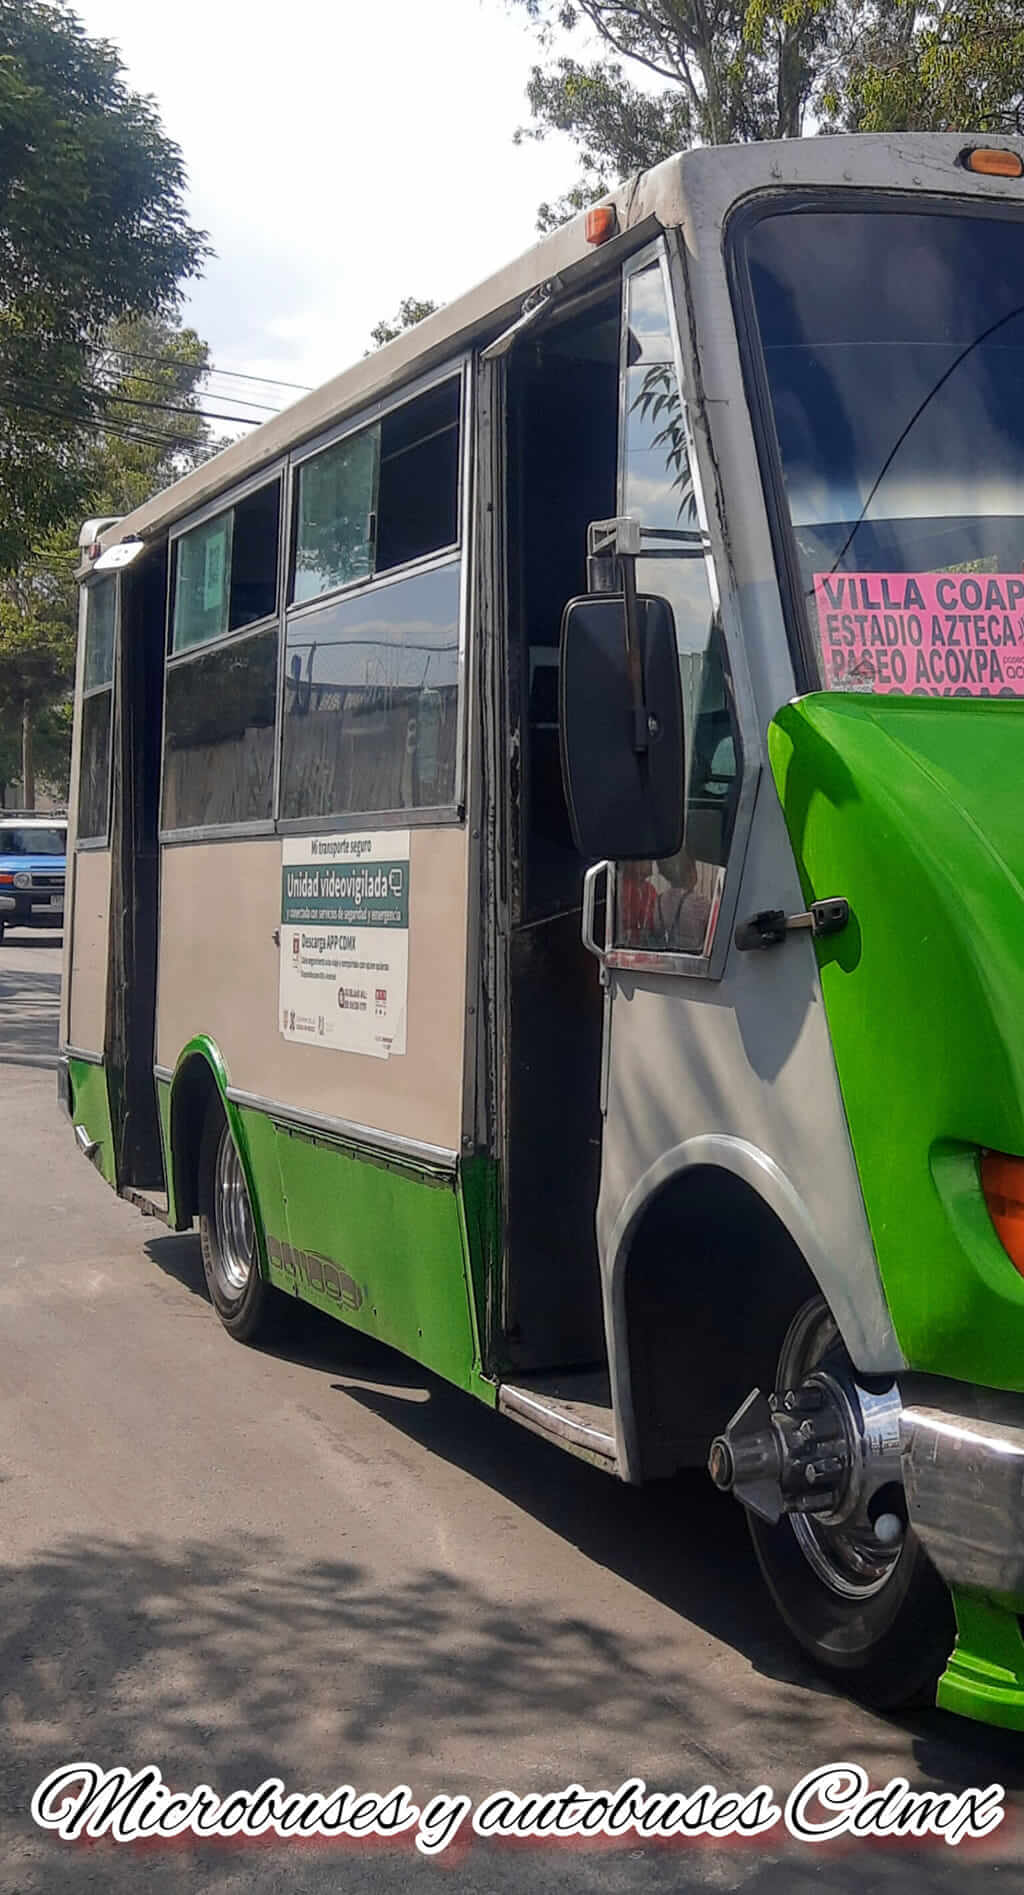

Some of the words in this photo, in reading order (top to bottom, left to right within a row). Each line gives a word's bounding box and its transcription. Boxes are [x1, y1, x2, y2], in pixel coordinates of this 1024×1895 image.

[822, 577, 926, 610] VILLA
[827, 614, 922, 647] ESTADIO
[931, 614, 1017, 647] AZTECA
[832, 648, 907, 684] PASEO
[916, 648, 1004, 684] ACOXPA
[318, 839, 349, 858] transporte
[350, 839, 372, 857] seguro
[287, 870, 319, 897] Unidad
[320, 868, 388, 904] videovigilada
[301, 934, 326, 953] Descarga
[327, 935, 338, 950] APP
